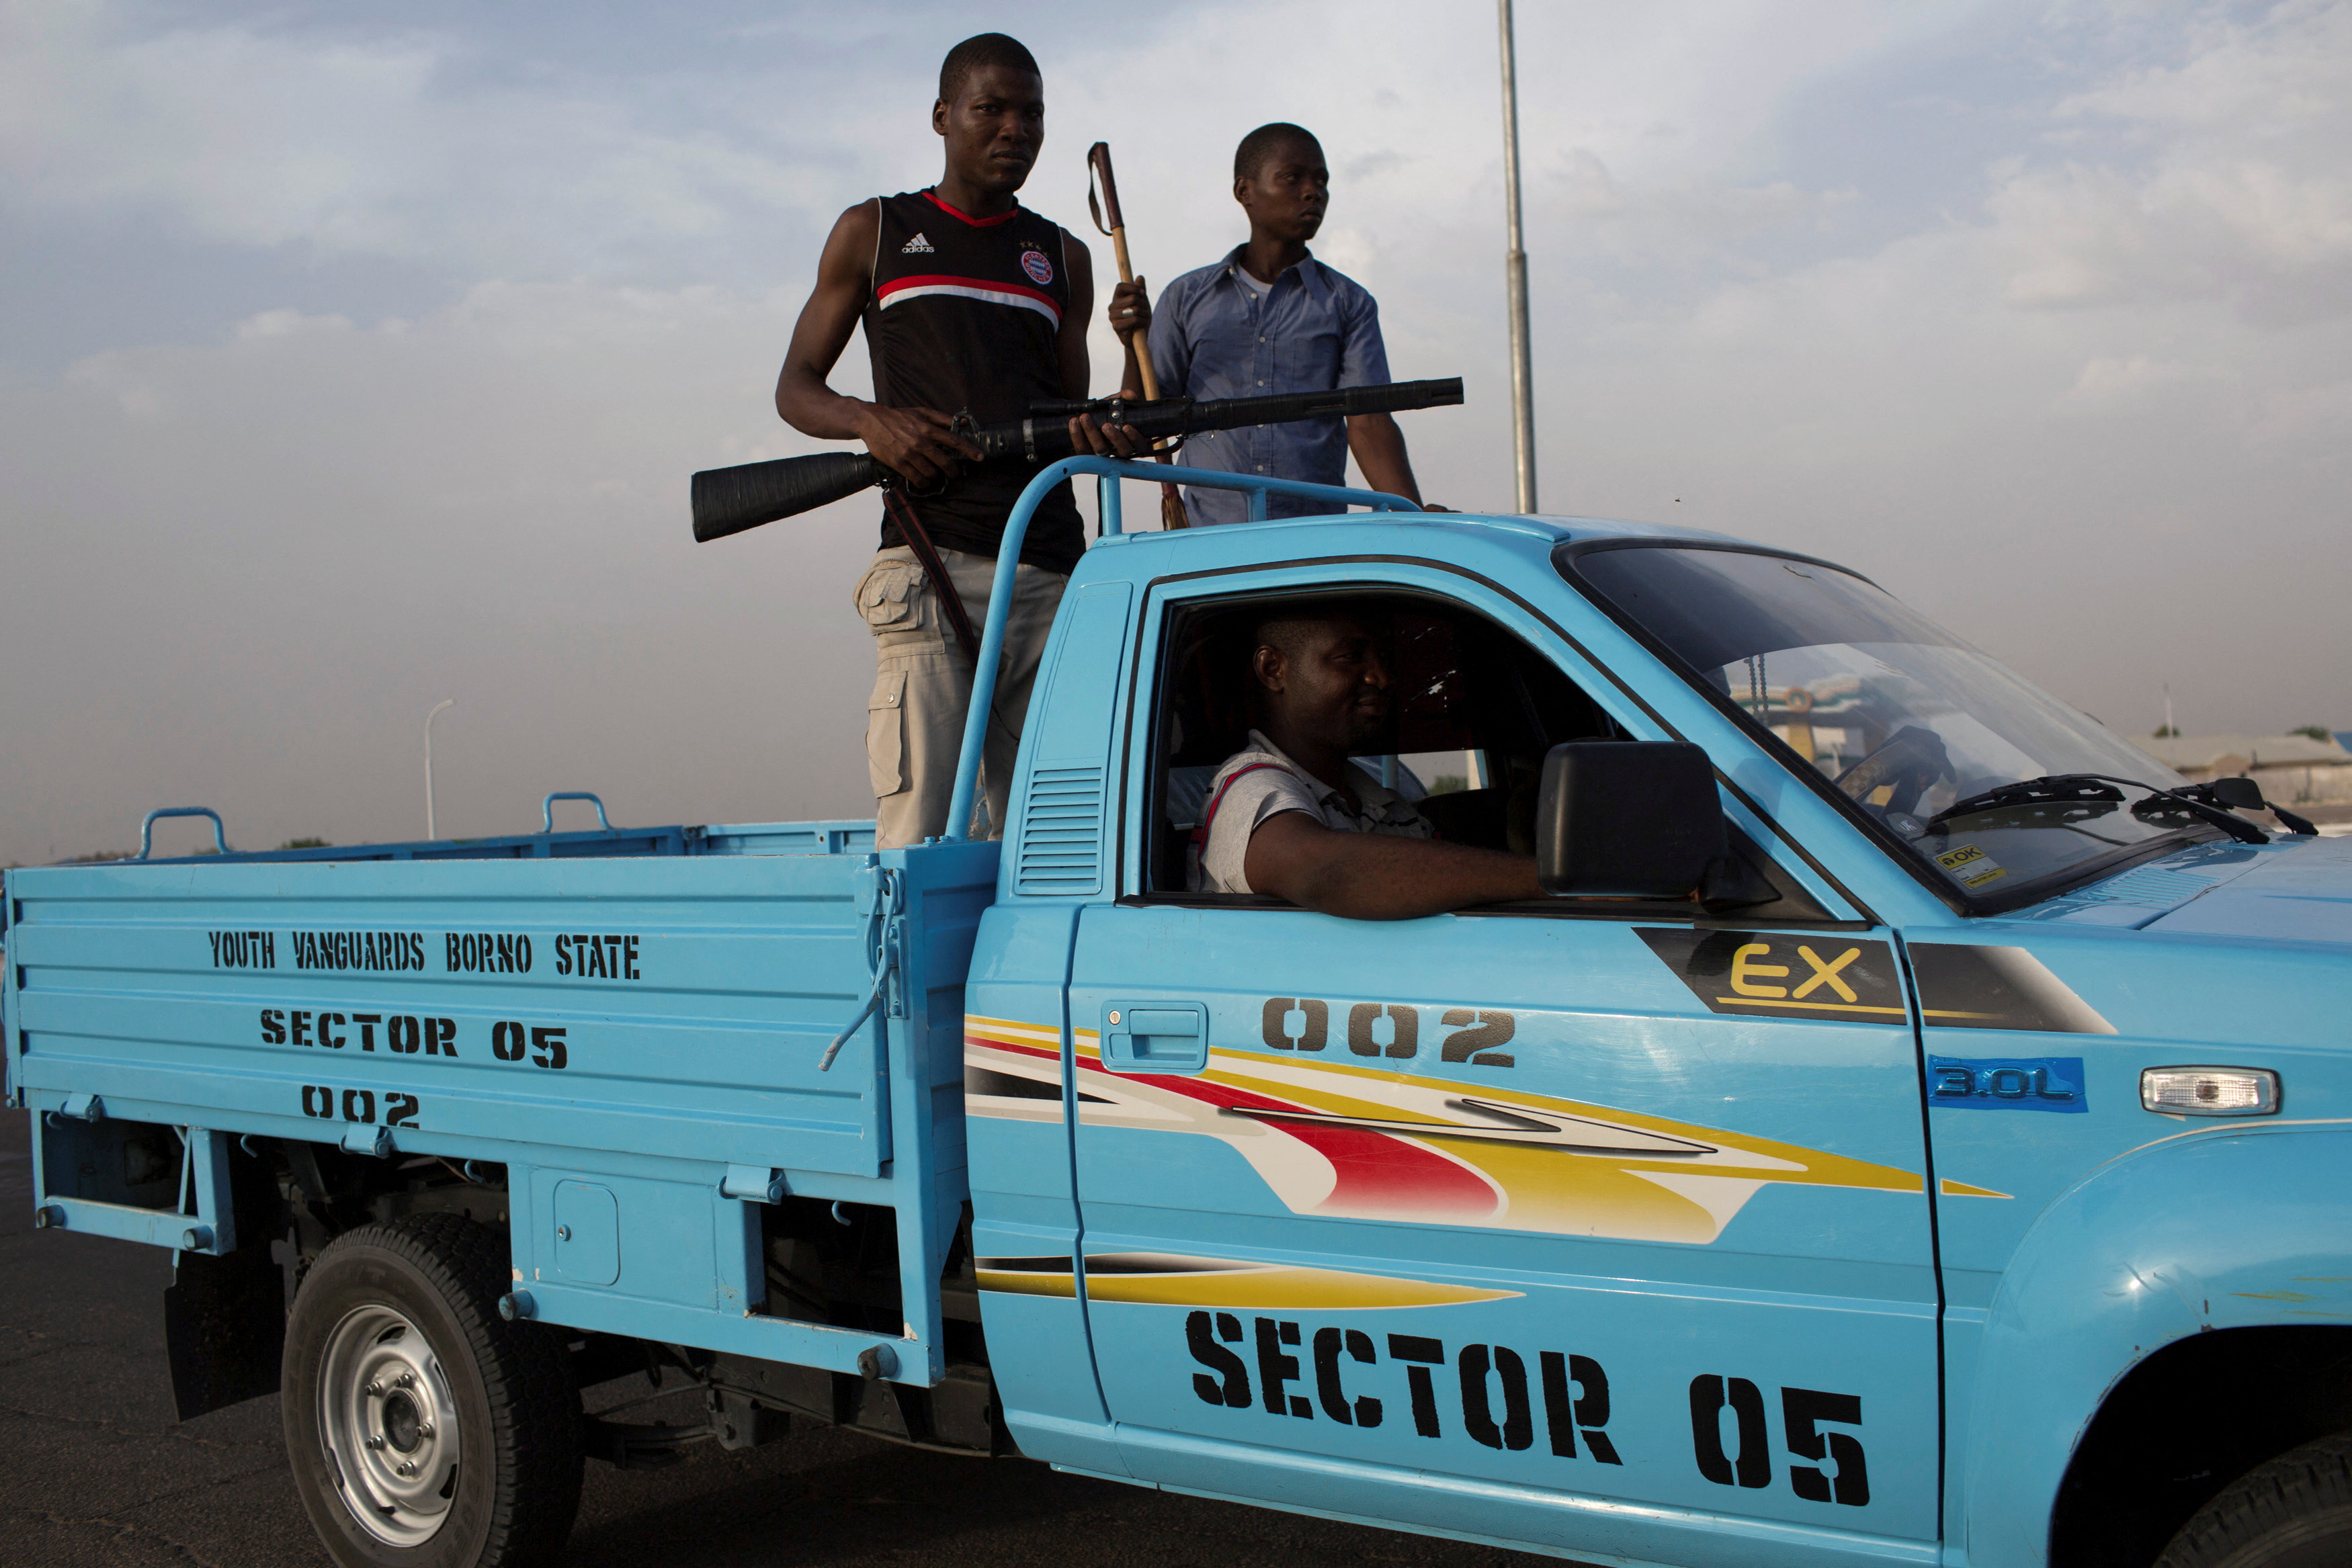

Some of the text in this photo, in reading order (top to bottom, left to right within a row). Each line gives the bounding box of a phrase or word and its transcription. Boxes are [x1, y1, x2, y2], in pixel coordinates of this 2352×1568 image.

[902, 245, 935, 253] adidas
[1954, 847, 1982, 861] OK
[208, 931, 640, 980] YOUTH VANGUARDS BORNO STATE
[1730, 943, 1861, 1002] EX
[260, 1009, 568, 1070] SECTOR 05
[1263, 997, 1515, 1068] 002
[1934, 1065, 2075, 1100] 3.0L
[301, 1085, 420, 1130] 002
[1185, 1310, 1871, 1508] SECTOR 05
